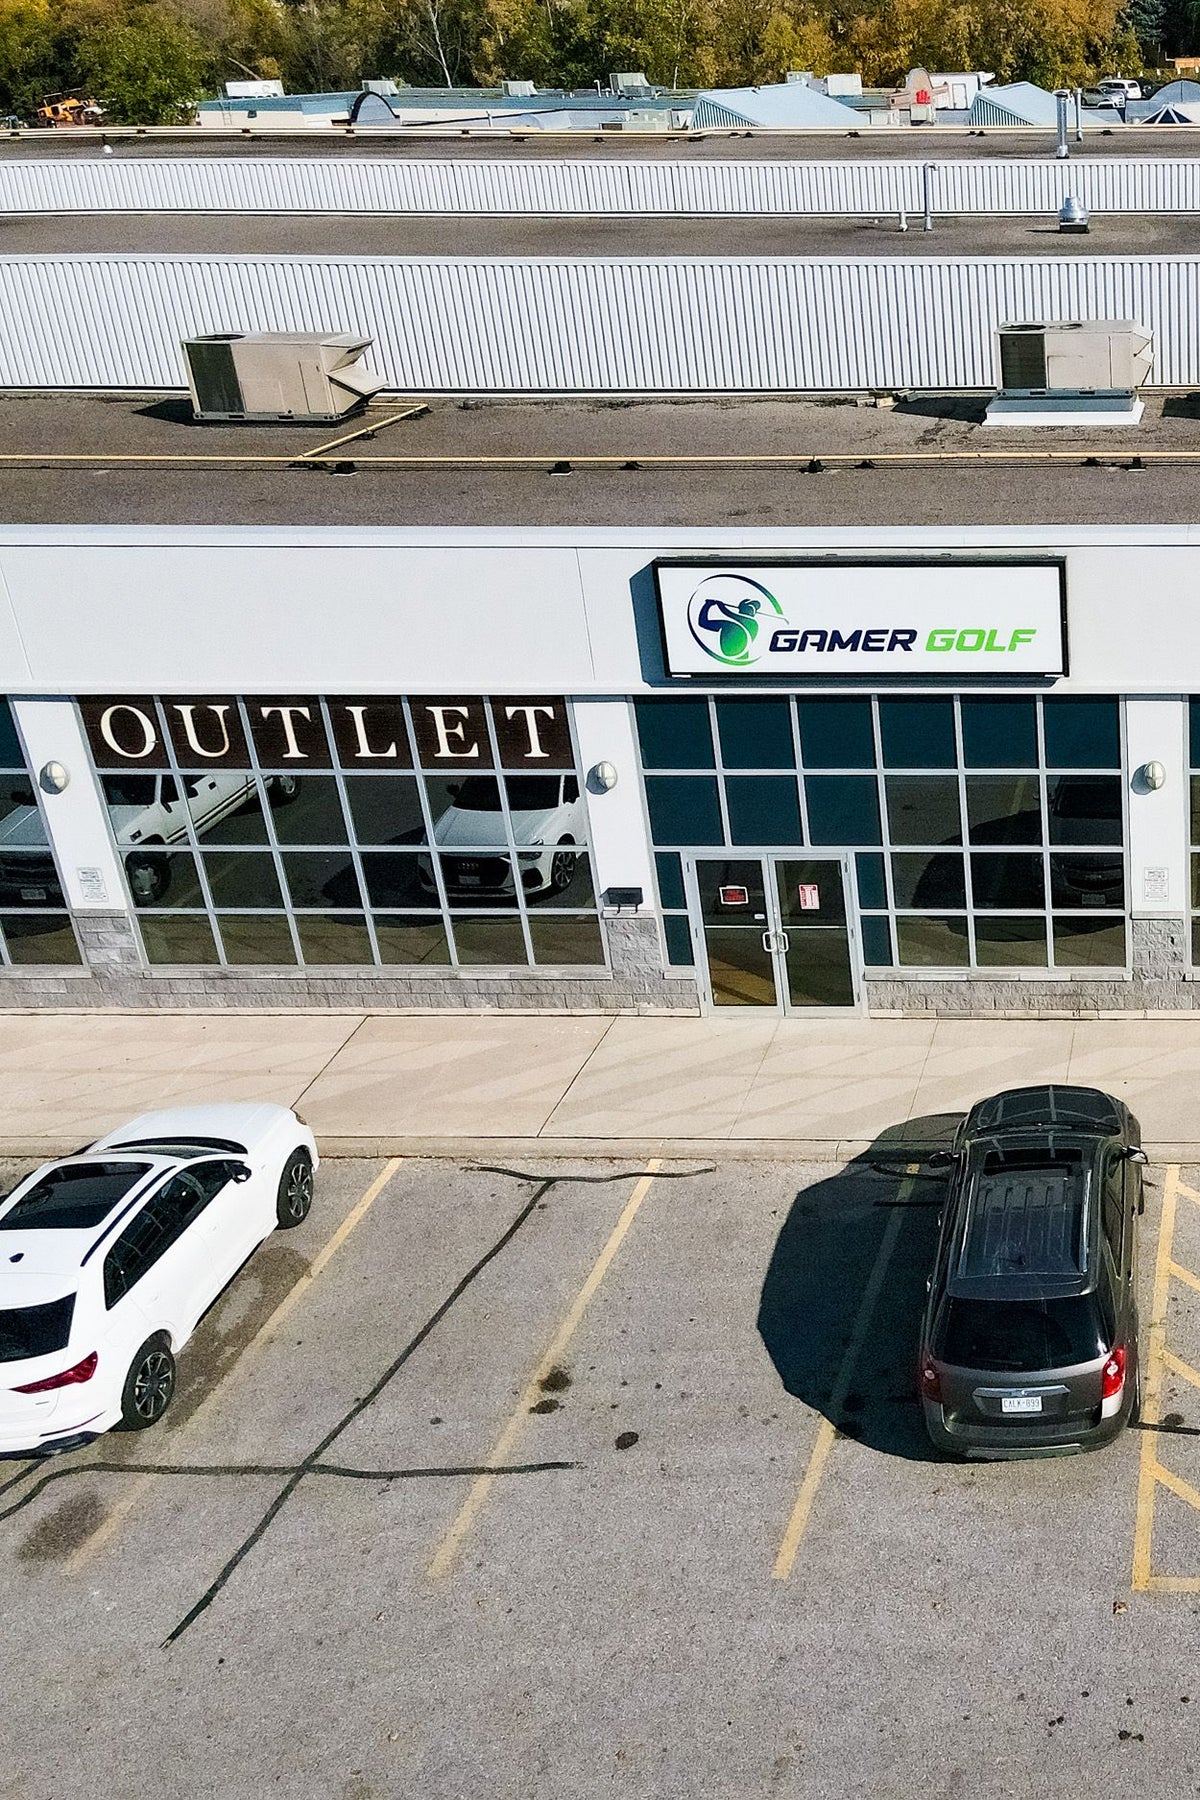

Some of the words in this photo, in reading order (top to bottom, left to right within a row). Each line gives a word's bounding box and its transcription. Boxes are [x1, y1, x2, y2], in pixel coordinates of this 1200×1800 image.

[768, 628, 918, 653] GAMER
[925, 628, 1037, 652] GOLF
[99, 704, 555, 760] OUTLET
